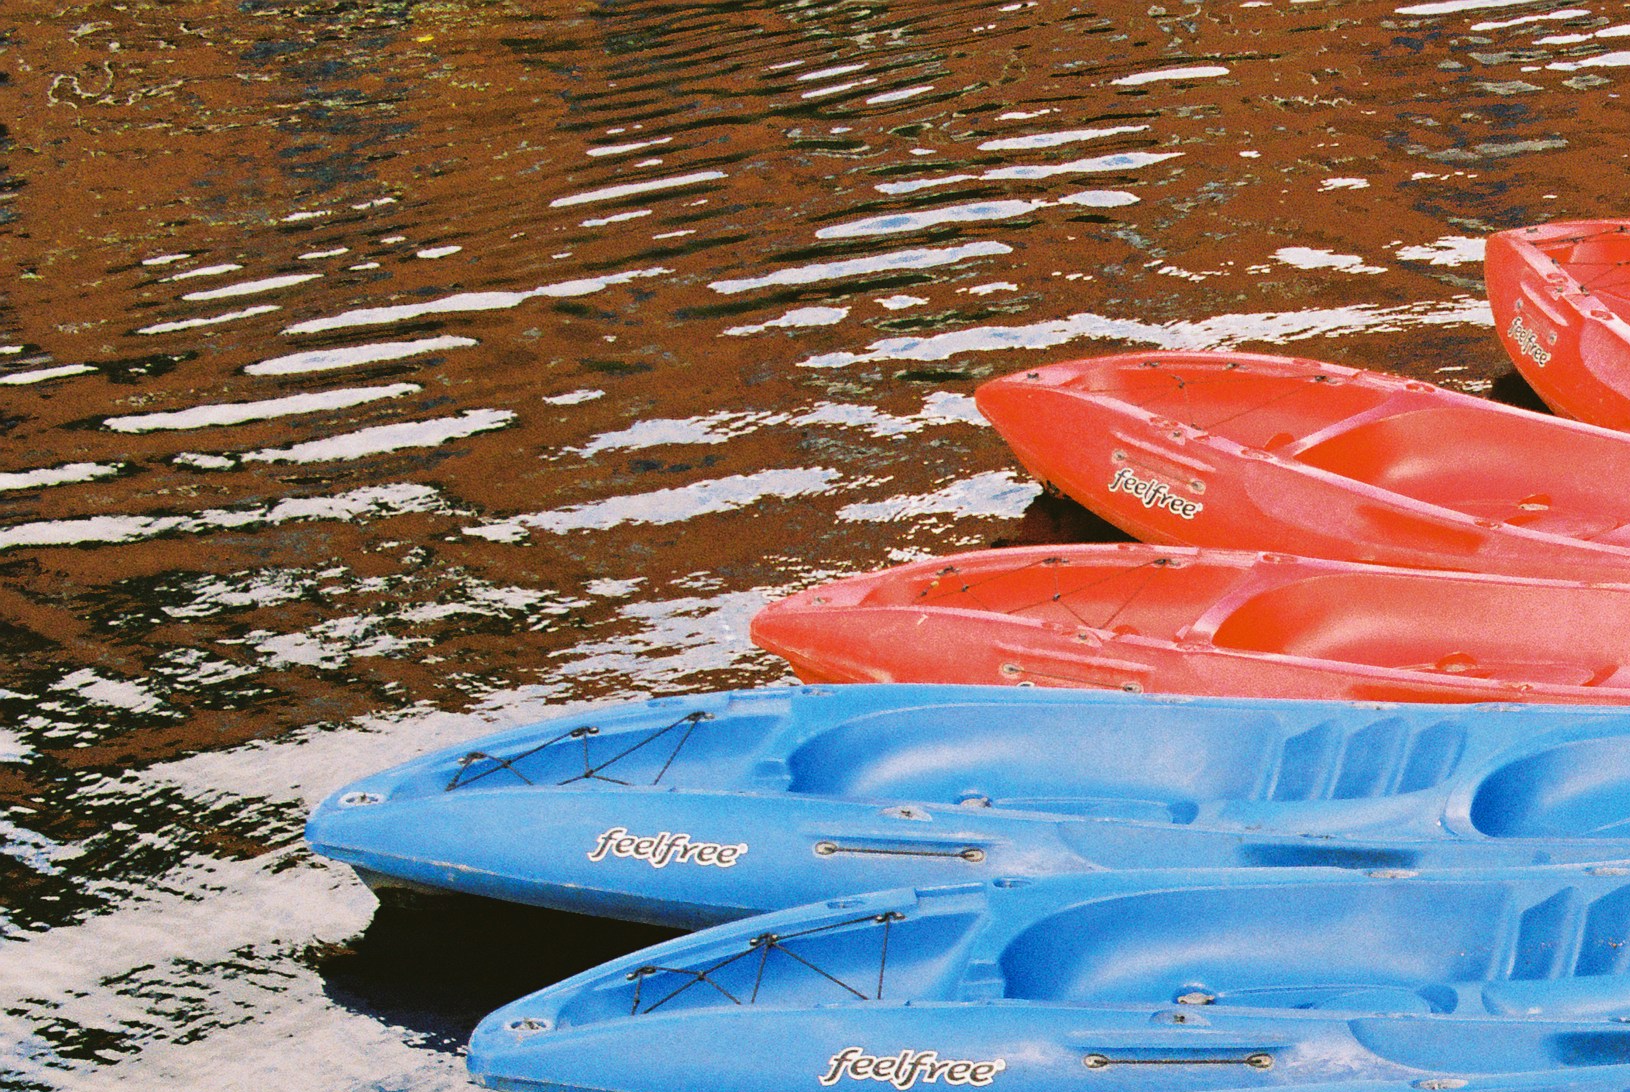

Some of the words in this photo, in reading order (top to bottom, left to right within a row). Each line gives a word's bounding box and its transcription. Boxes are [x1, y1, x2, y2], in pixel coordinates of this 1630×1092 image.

[1508, 317, 1549, 366] feelfree
[1109, 470, 1198, 518] feelfree
[589, 828, 740, 867] feelfree
[820, 1048, 998, 1088] feelfree
